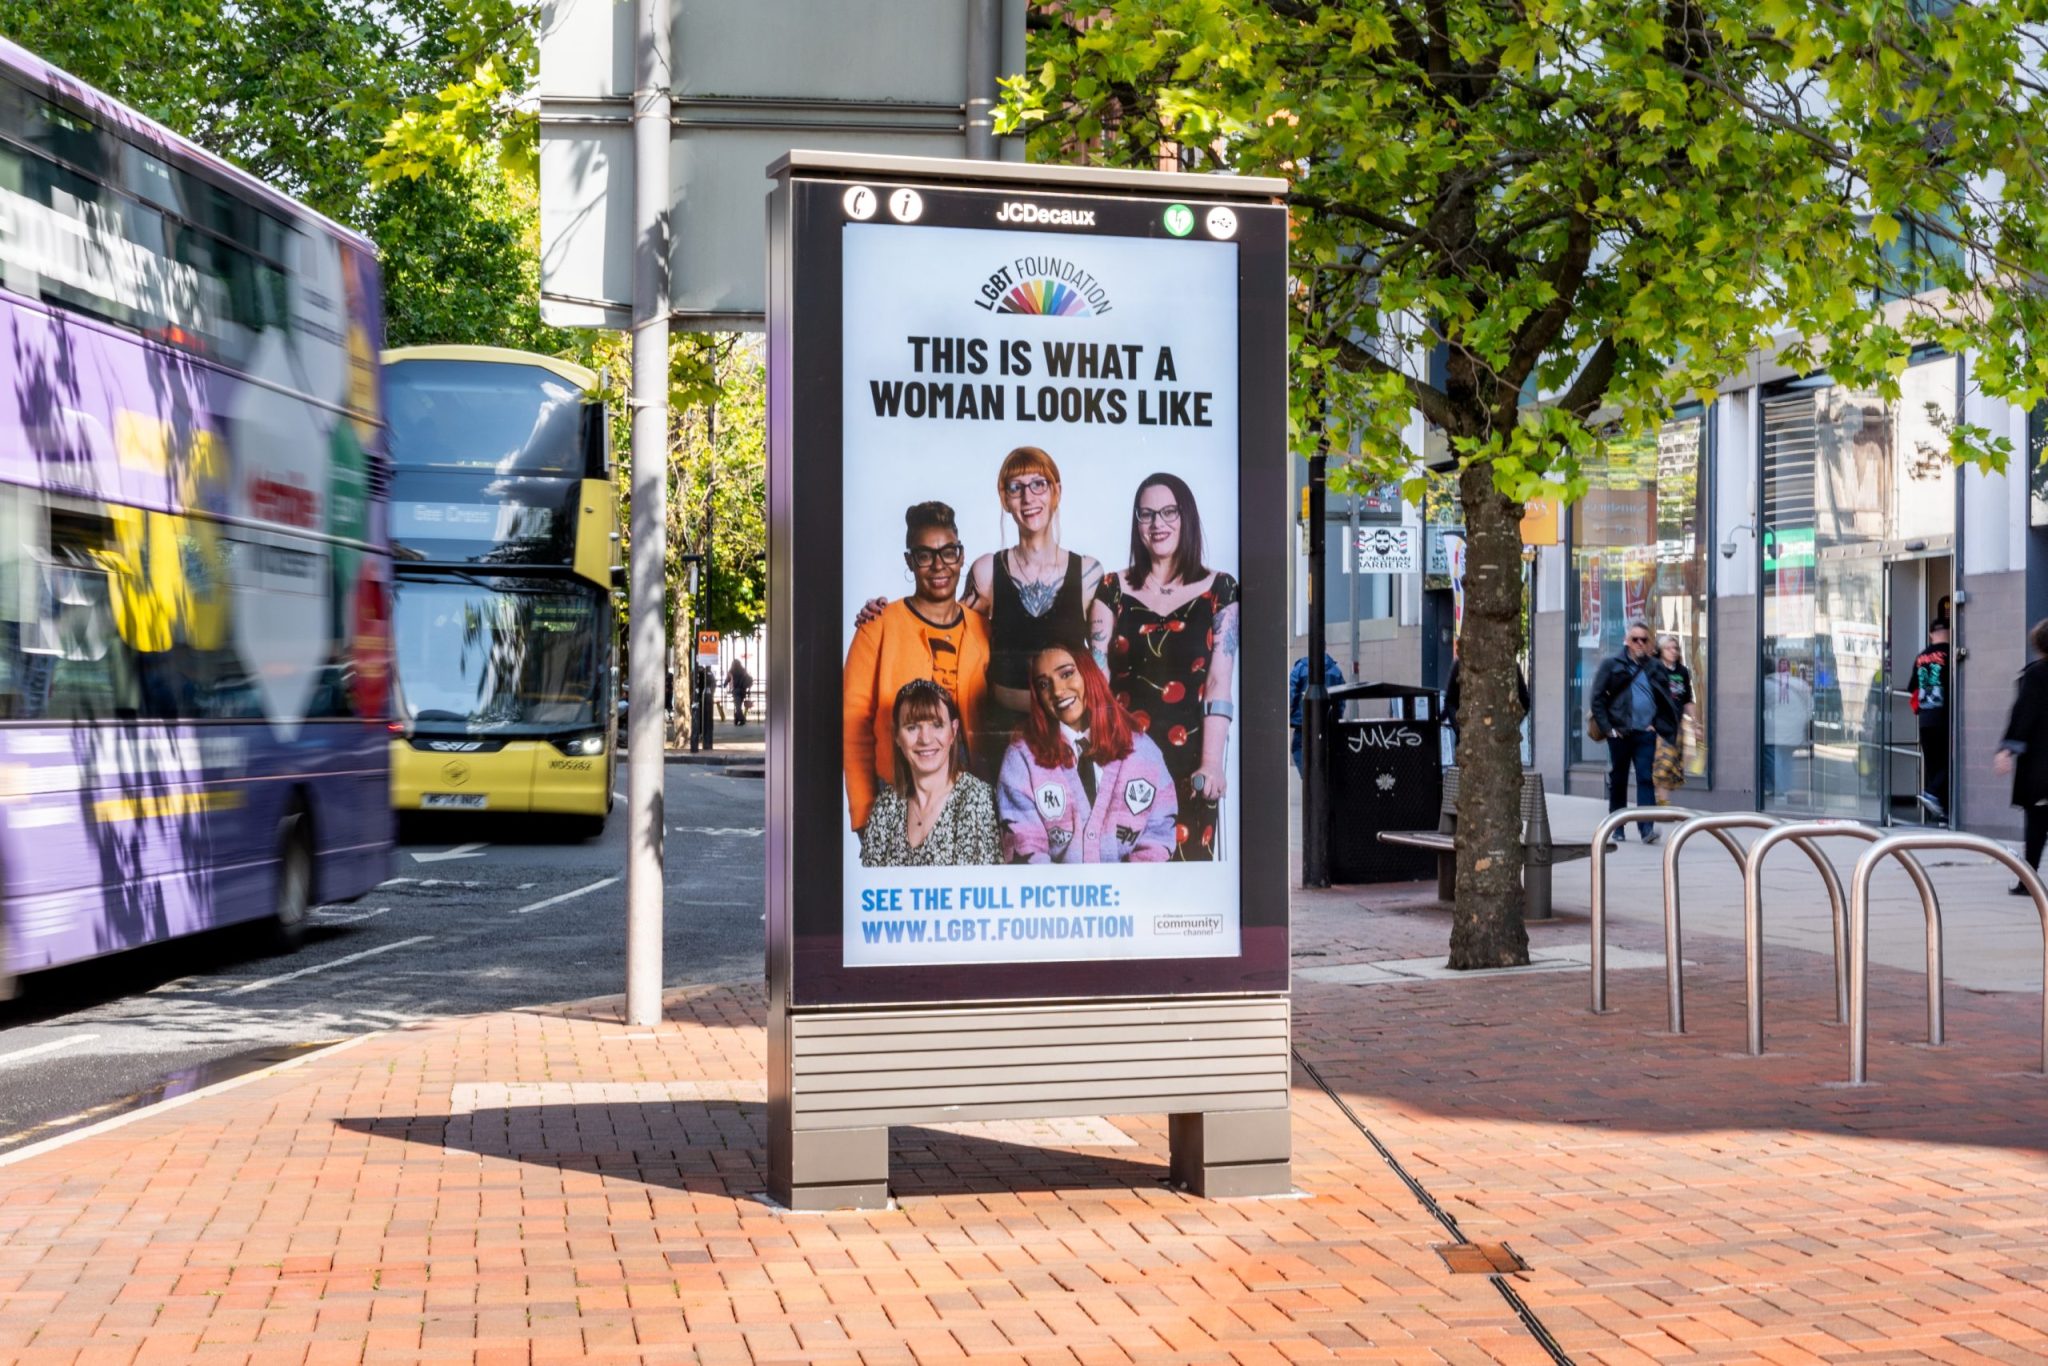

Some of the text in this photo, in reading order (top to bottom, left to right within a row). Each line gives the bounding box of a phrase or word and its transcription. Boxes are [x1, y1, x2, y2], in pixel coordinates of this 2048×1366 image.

[996, 202, 1096, 225] JCDecaux
[974, 255, 1113, 316] LGBT FOUNDATION
[908, 336, 1177, 381] THIS IS WHAT A
[870, 380, 1213, 427] WOMAN LOOKS LIKE
[861, 884, 1120, 912] SEE THE FULL PICTURE:
[861, 915, 1134, 944] WWW.LGBT.FOUNDATION
[1157, 917, 1220, 929] community
[1183, 928, 1214, 936] channel
